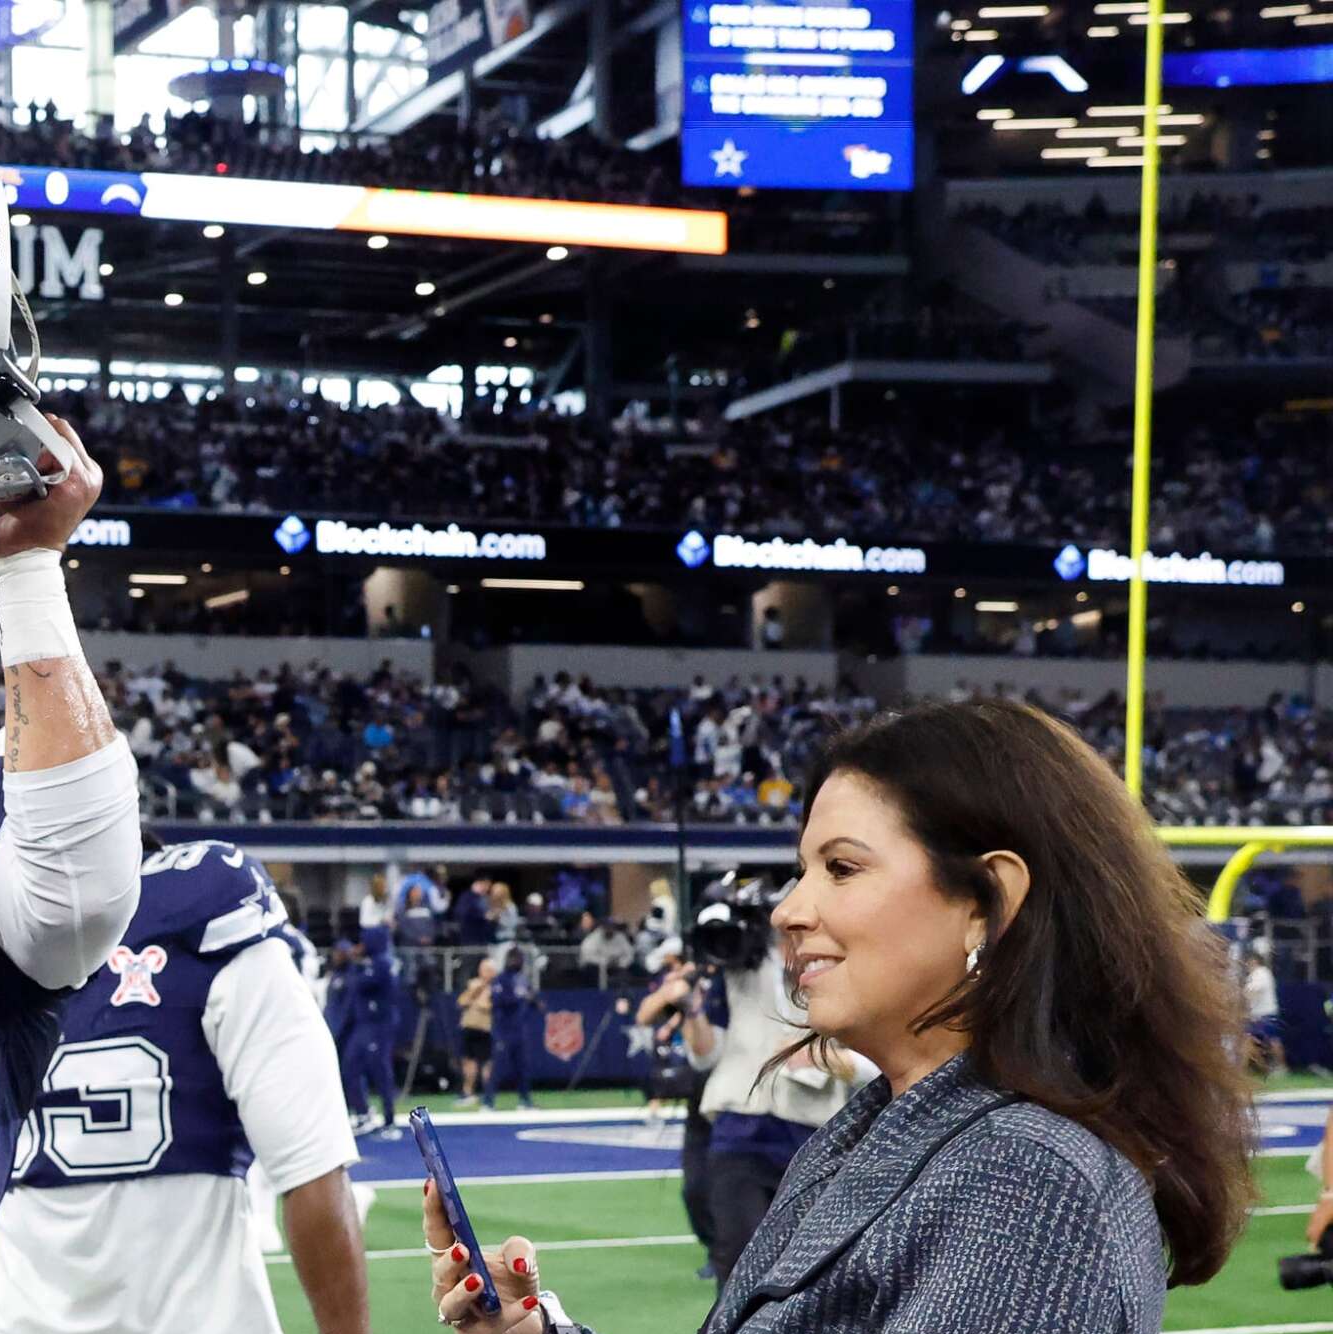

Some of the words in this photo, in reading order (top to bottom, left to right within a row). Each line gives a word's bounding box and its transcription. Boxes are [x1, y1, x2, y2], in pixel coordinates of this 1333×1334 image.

[45, 171, 69, 205] 0
[316, 518, 546, 560] Blockchain.com
[713, 534, 926, 574] Blockchain.com
[1088, 549, 1284, 585] Blokchain.com
